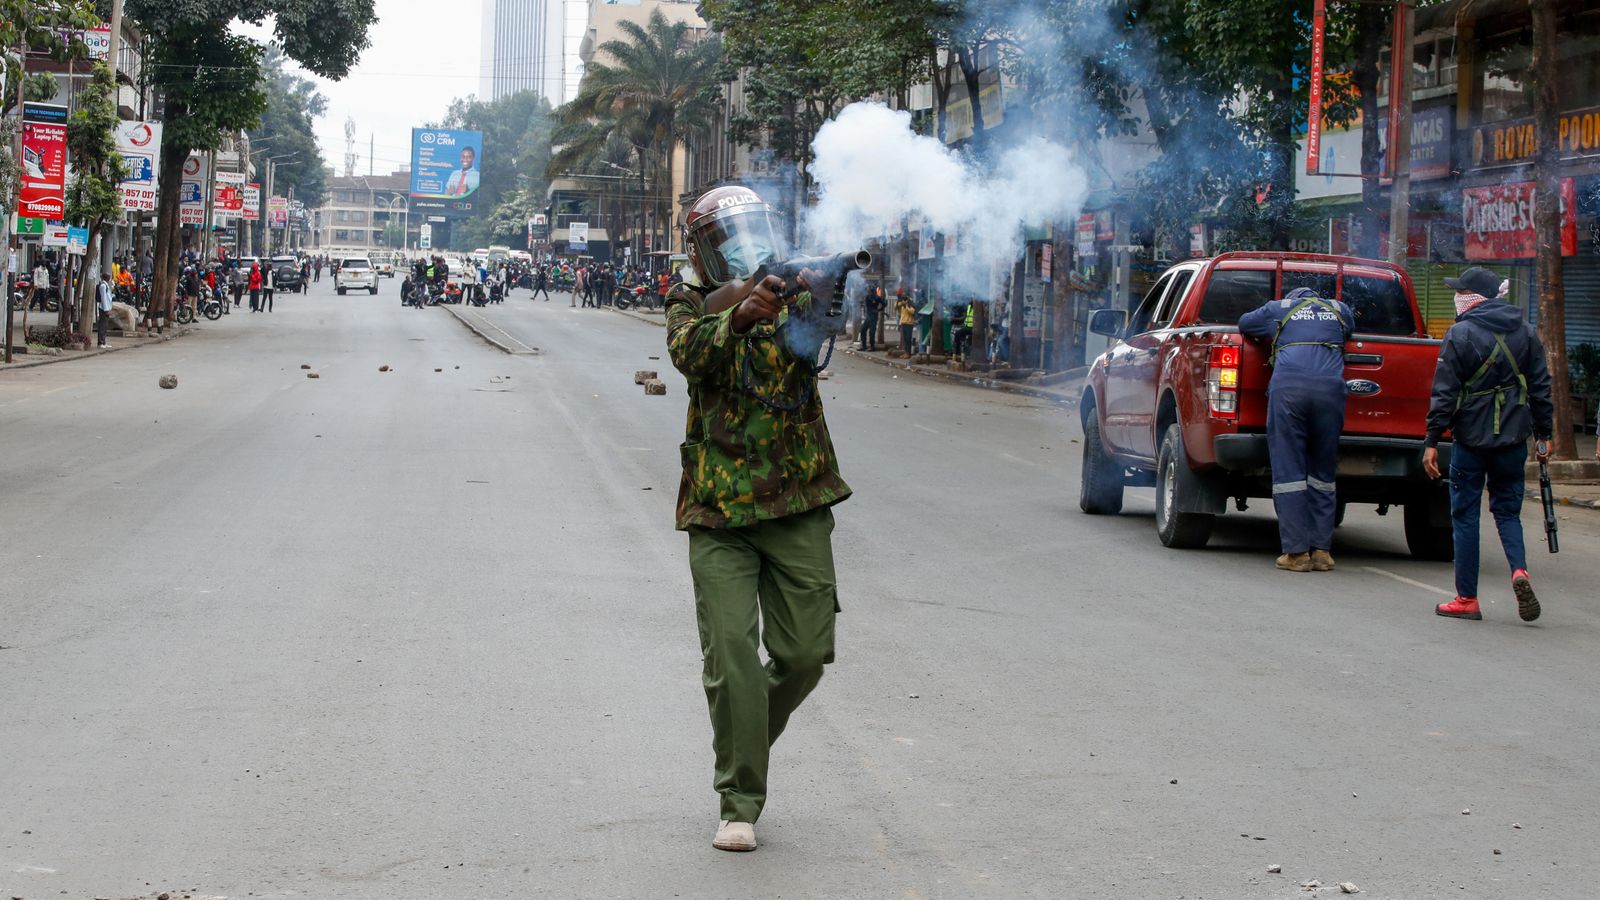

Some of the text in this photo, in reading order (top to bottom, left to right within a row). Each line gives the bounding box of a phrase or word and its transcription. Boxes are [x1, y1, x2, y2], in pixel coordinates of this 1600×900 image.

[1315, 27, 1321, 39] 17
[86, 35, 110, 47] bab
[1494, 112, 1600, 160] ROYA POON
[123, 158, 145, 169] VERTISE
[142, 191, 154, 199] 017
[139, 200, 153, 209] 736
[1351, 381, 1372, 391] Ford
